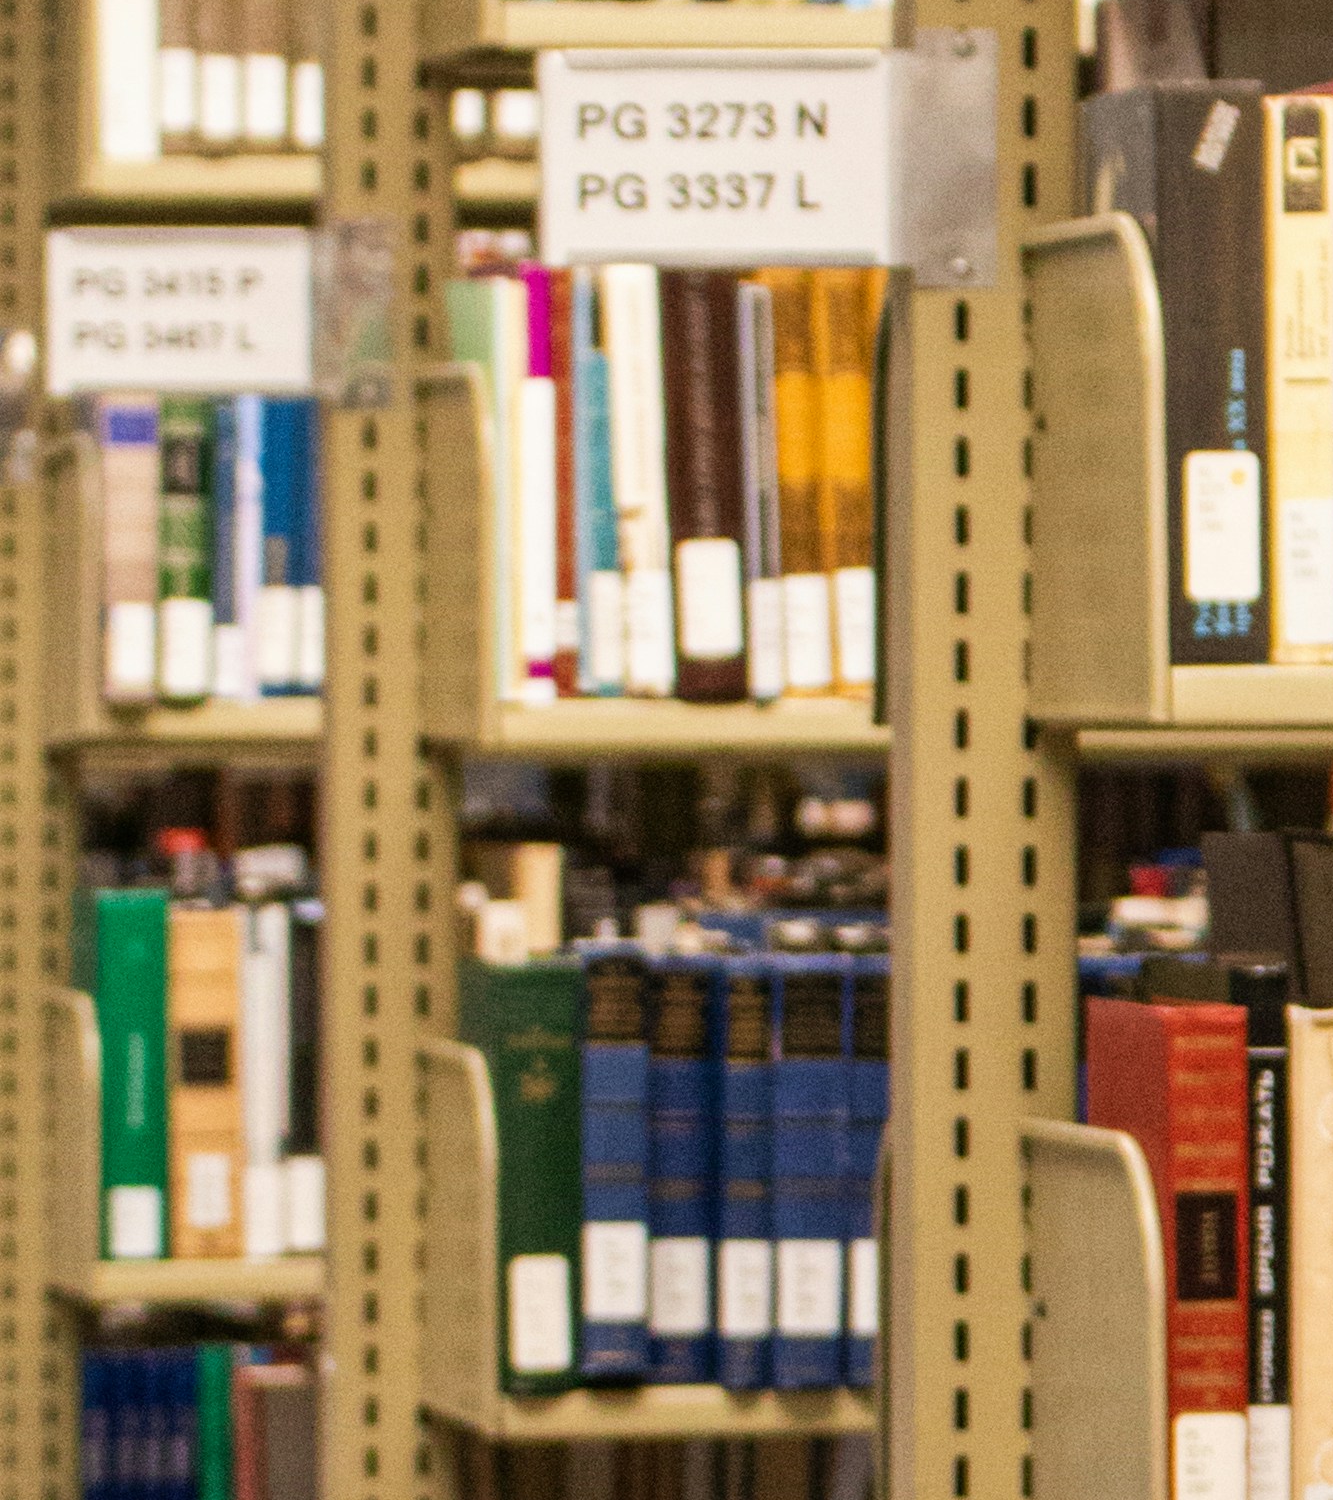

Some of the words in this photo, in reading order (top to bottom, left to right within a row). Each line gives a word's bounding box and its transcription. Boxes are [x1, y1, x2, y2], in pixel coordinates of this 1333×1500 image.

[576, 101, 648, 140] PG
[666, 101, 776, 140] 3273
[795, 100, 828, 140] N
[576, 172, 648, 213] PG
[666, 172, 776, 212] 3337
[795, 170, 821, 212] L
